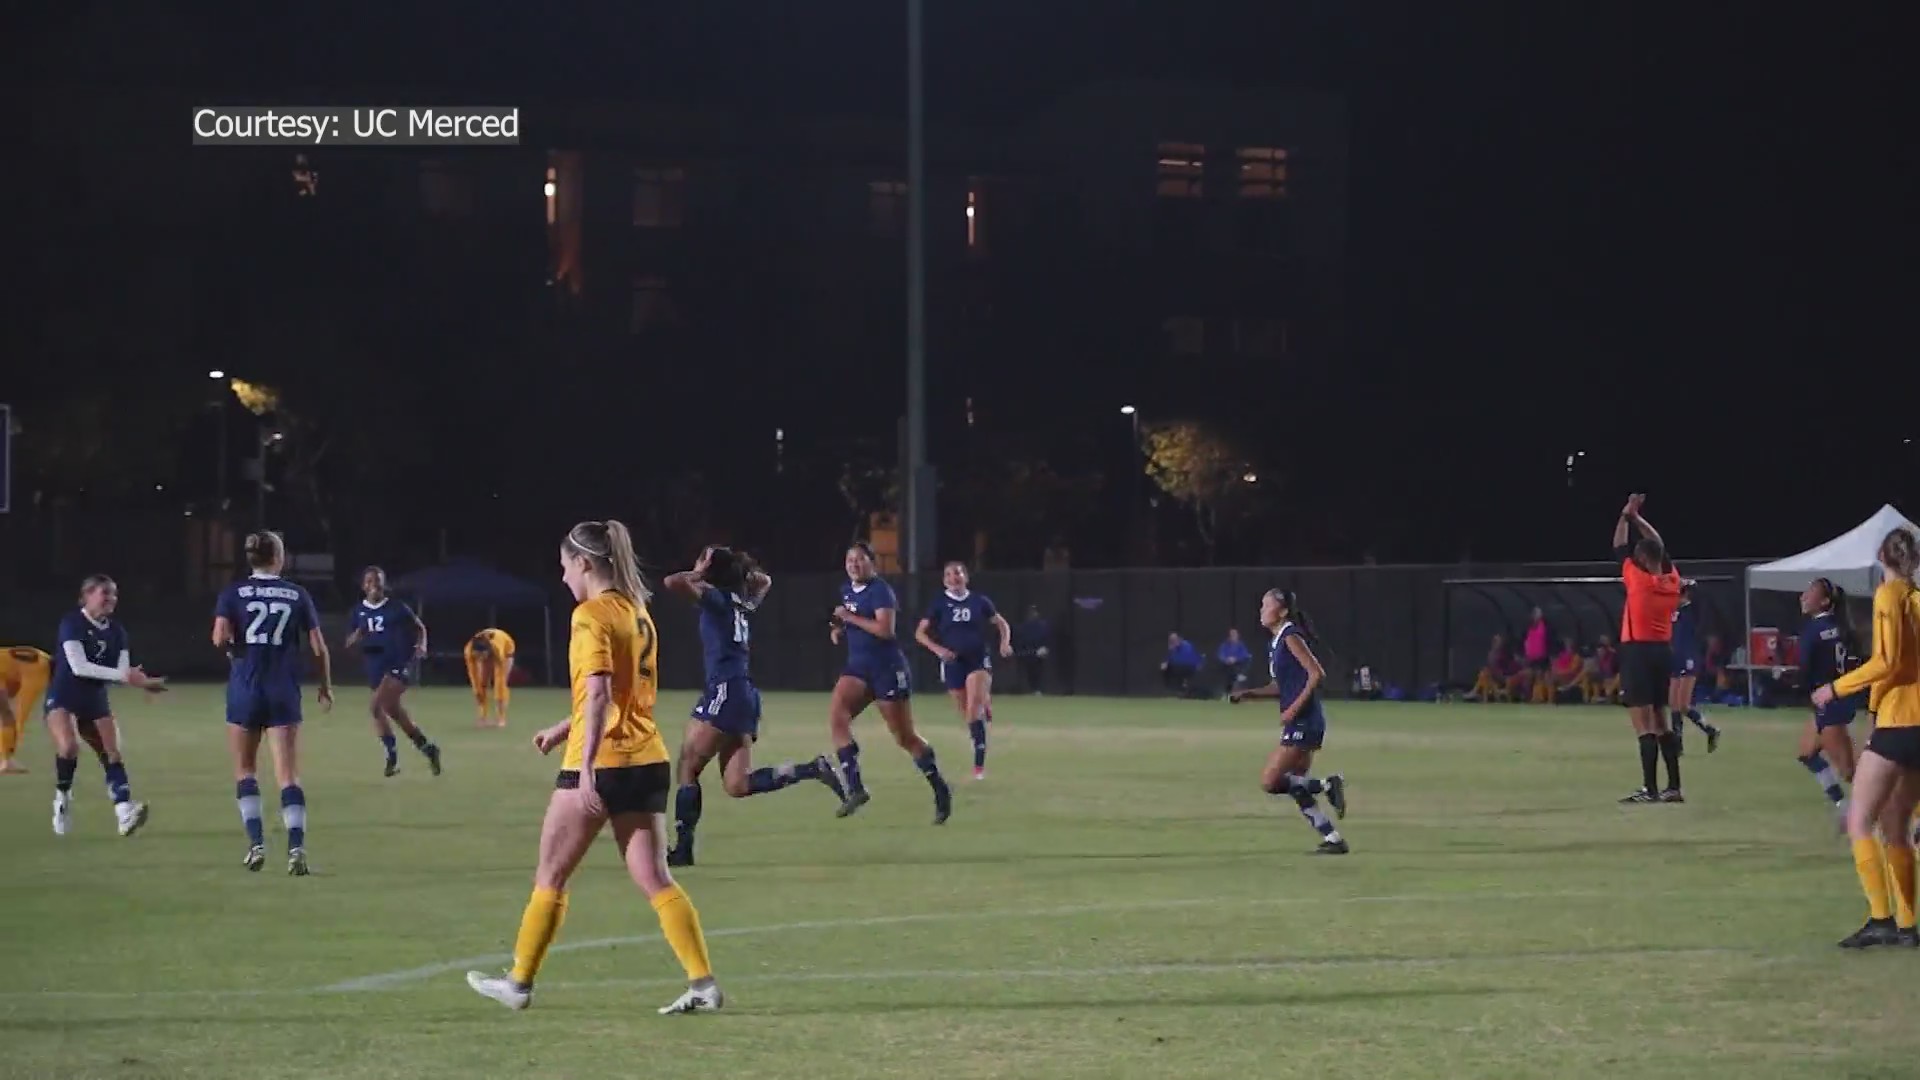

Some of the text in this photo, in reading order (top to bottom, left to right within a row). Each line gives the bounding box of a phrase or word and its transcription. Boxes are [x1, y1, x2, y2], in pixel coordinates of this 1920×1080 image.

[245, 601, 291, 645] 27
[367, 616, 385, 632] 12
[952, 608, 972, 622] 20
[637, 617, 653, 677] 2
